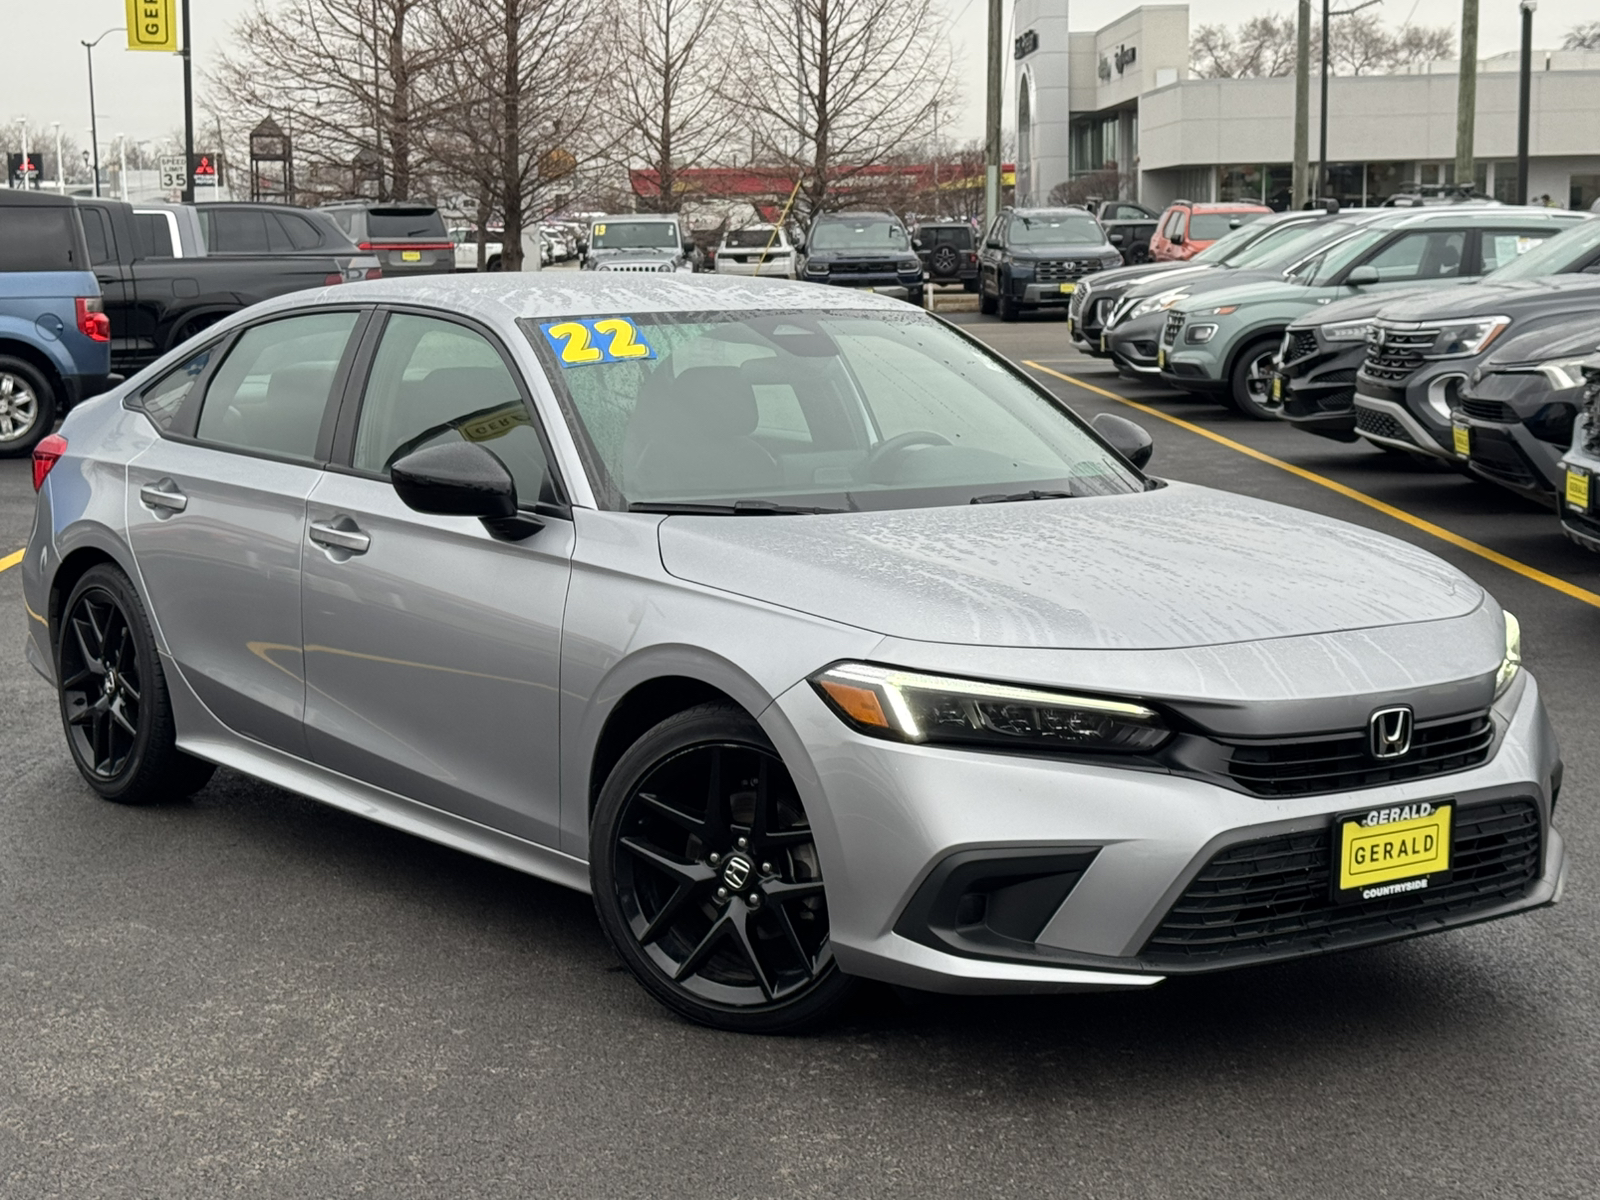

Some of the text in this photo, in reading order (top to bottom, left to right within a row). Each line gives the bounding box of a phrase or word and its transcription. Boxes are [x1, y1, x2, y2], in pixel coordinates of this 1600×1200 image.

[164, 174, 186, 187] 35
[548, 319, 650, 364] 22
[1366, 802, 1432, 827] GERALD
[1354, 834, 1434, 865] GERALD
[1362, 878, 1428, 899] COUNTRYSIDE
